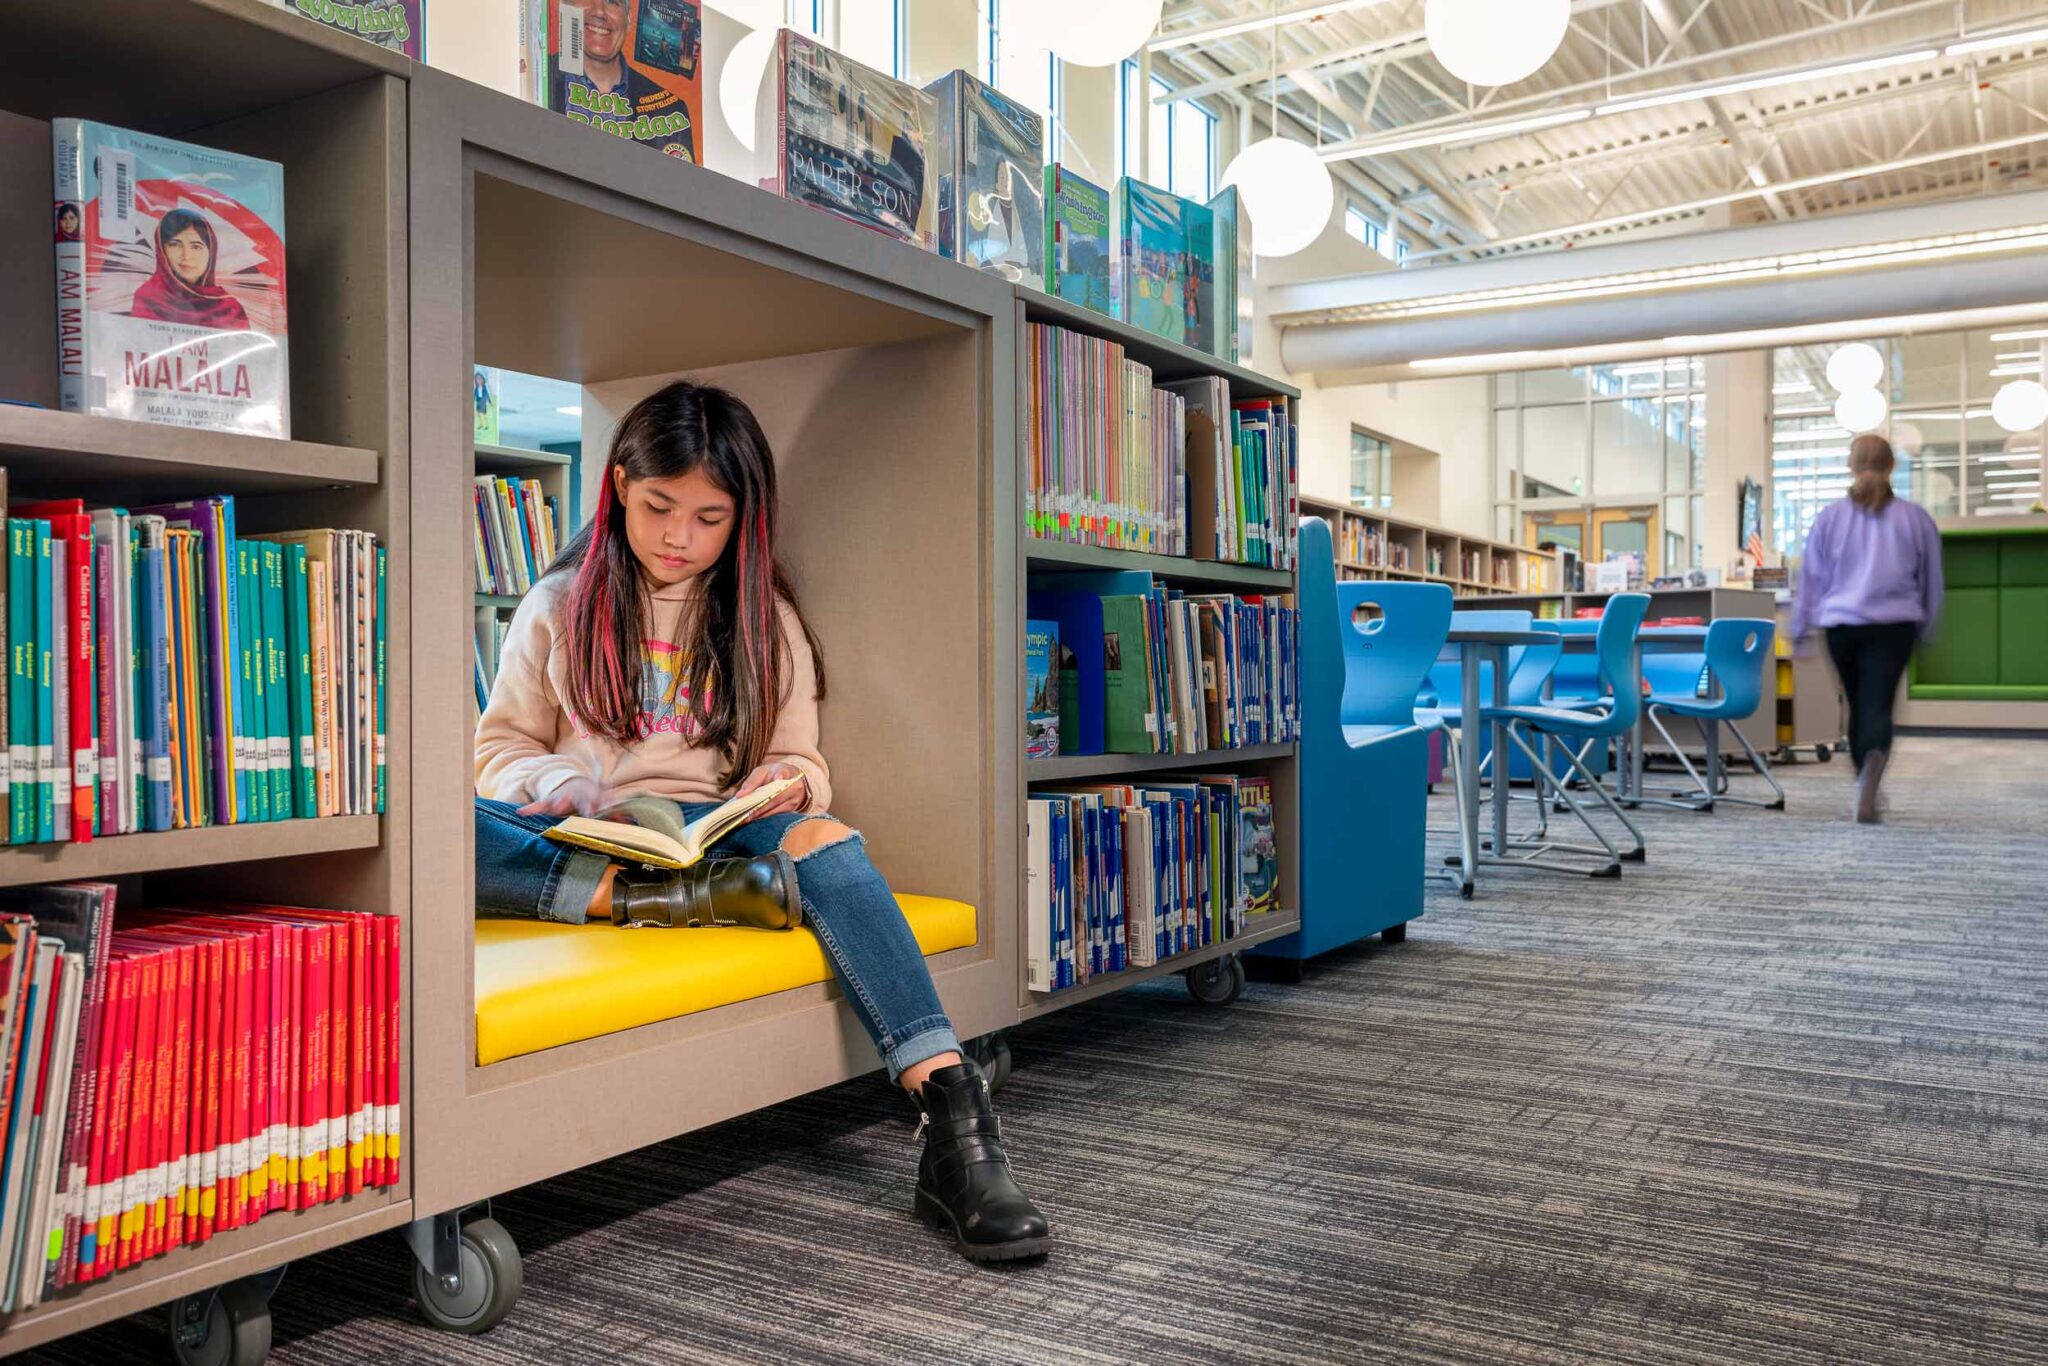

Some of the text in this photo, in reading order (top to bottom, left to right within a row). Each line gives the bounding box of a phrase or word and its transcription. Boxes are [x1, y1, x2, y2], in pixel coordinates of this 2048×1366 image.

[568, 82, 633, 116] Rick
[636, 96, 678, 113] STORYTELLERS
[792, 150, 864, 203] PAPER
[871, 180, 913, 219] SON
[59, 268, 81, 300] AM
[124, 350, 252, 399] MALALA
[147, 404, 182, 416] MALALA
[80, 565, 90, 660] Children of Slovakia
[100, 634, 109, 665] Count
[1026, 632, 1048, 648] ympic
[319, 646, 327, 673] Count
[100, 668, 109, 691] Your
[320, 675, 328, 695] Your
[635, 710, 705, 740] Bear
[91, 905, 100, 935] ARNOLD
[88, 939, 97, 966] HEWETT
